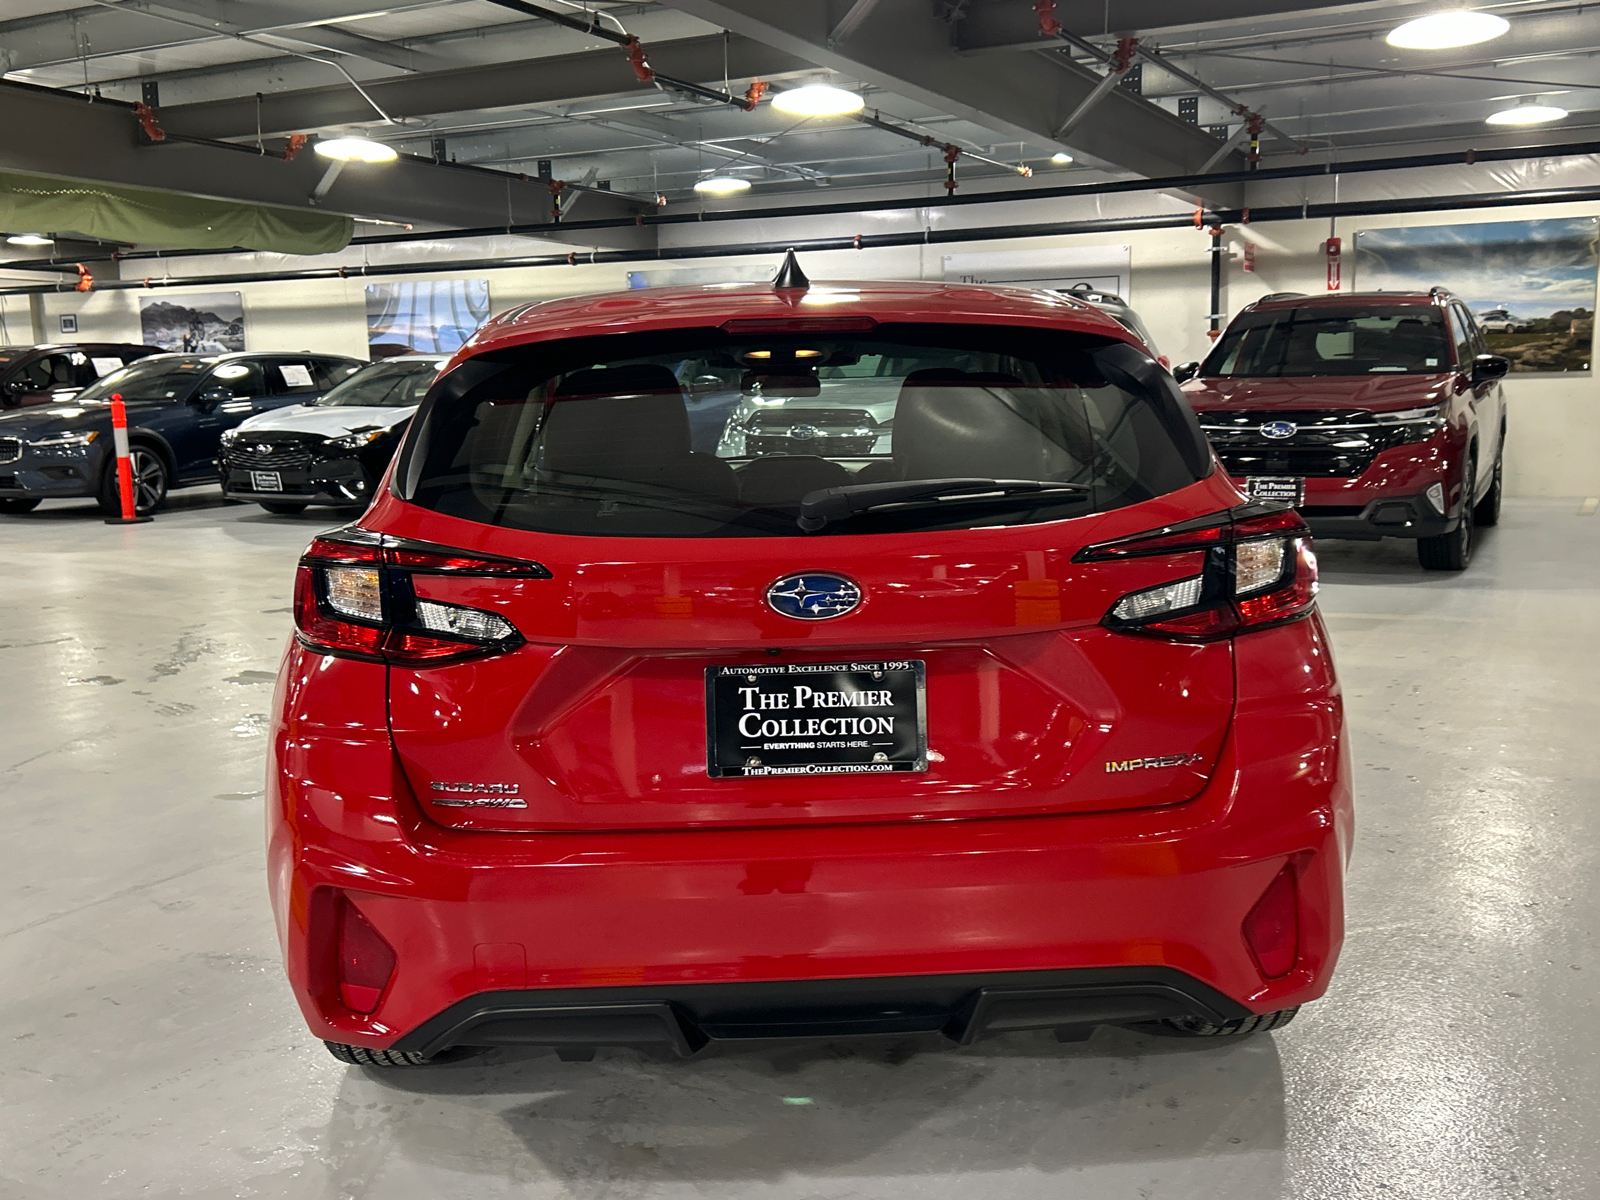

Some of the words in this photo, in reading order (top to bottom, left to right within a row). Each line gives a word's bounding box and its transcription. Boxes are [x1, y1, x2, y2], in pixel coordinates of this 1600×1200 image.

[883, 661, 909, 671] 1995
[738, 686, 790, 710] THE
[793, 685, 894, 709] PREMIER
[738, 712, 895, 738] COLLECTION
[763, 742, 815, 750] EVERYTHING
[816, 740, 846, 749] STARTS
[430, 781, 519, 794] SUBARU
